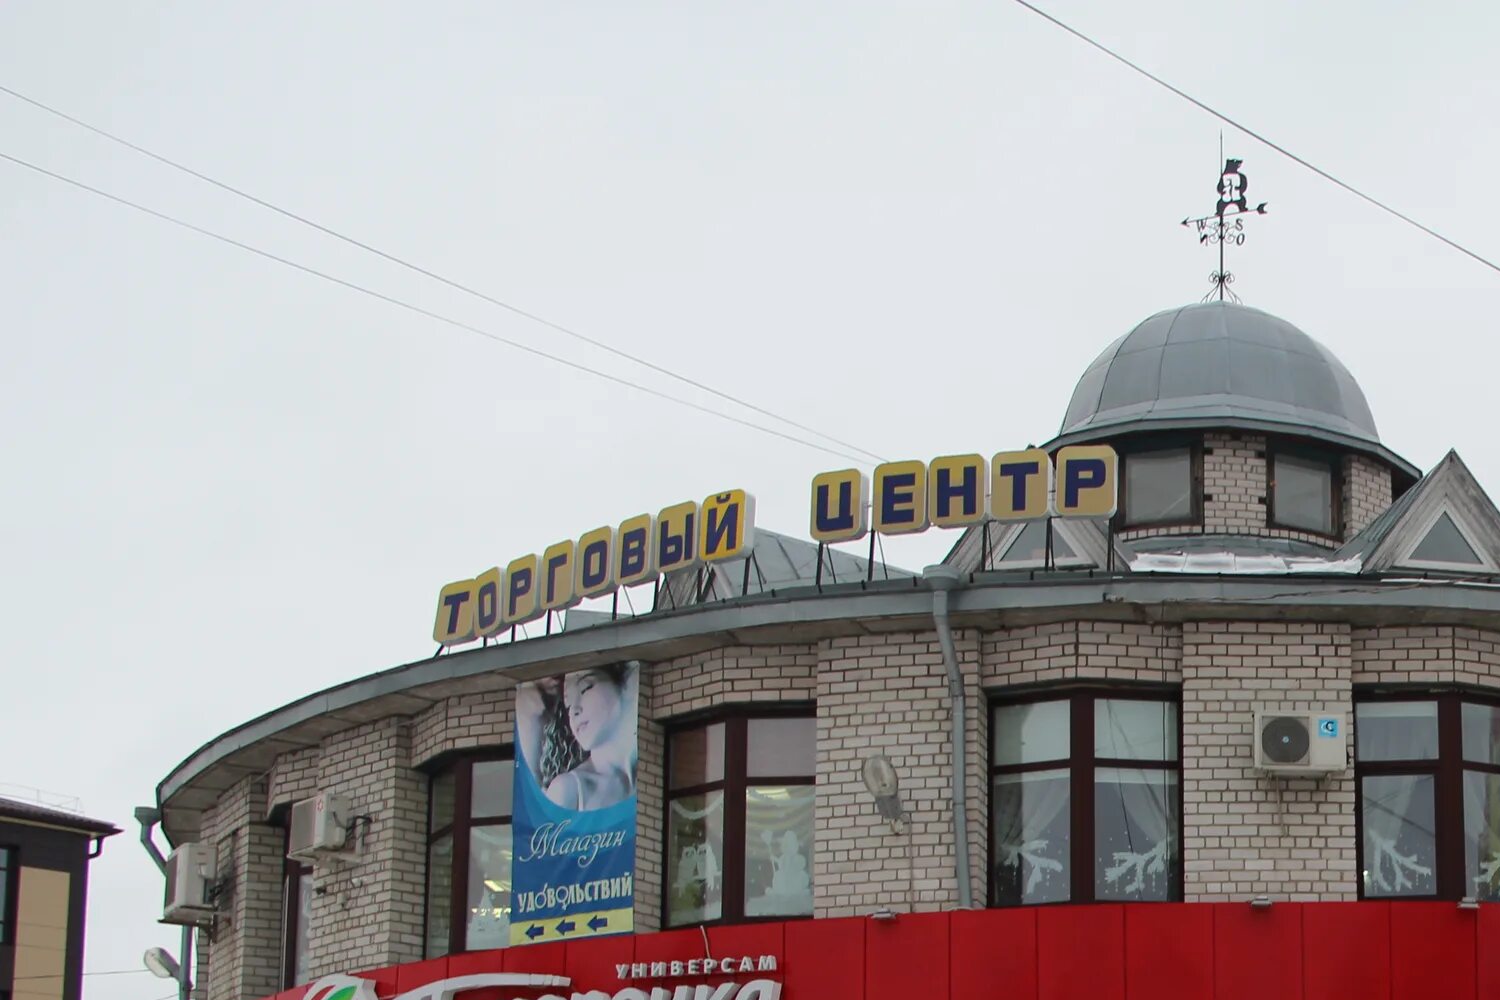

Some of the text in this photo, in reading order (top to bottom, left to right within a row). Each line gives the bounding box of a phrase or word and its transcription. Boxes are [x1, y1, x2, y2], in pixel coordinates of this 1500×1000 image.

[443, 457, 1107, 634] ТОРГОВЫЙ ЦЕНТР
[519, 819, 626, 868] Магазин
[518, 873, 632, 913] УДОВОЛЬСТВИЙ
[615, 954, 778, 980] УНИВЕРСАМ
